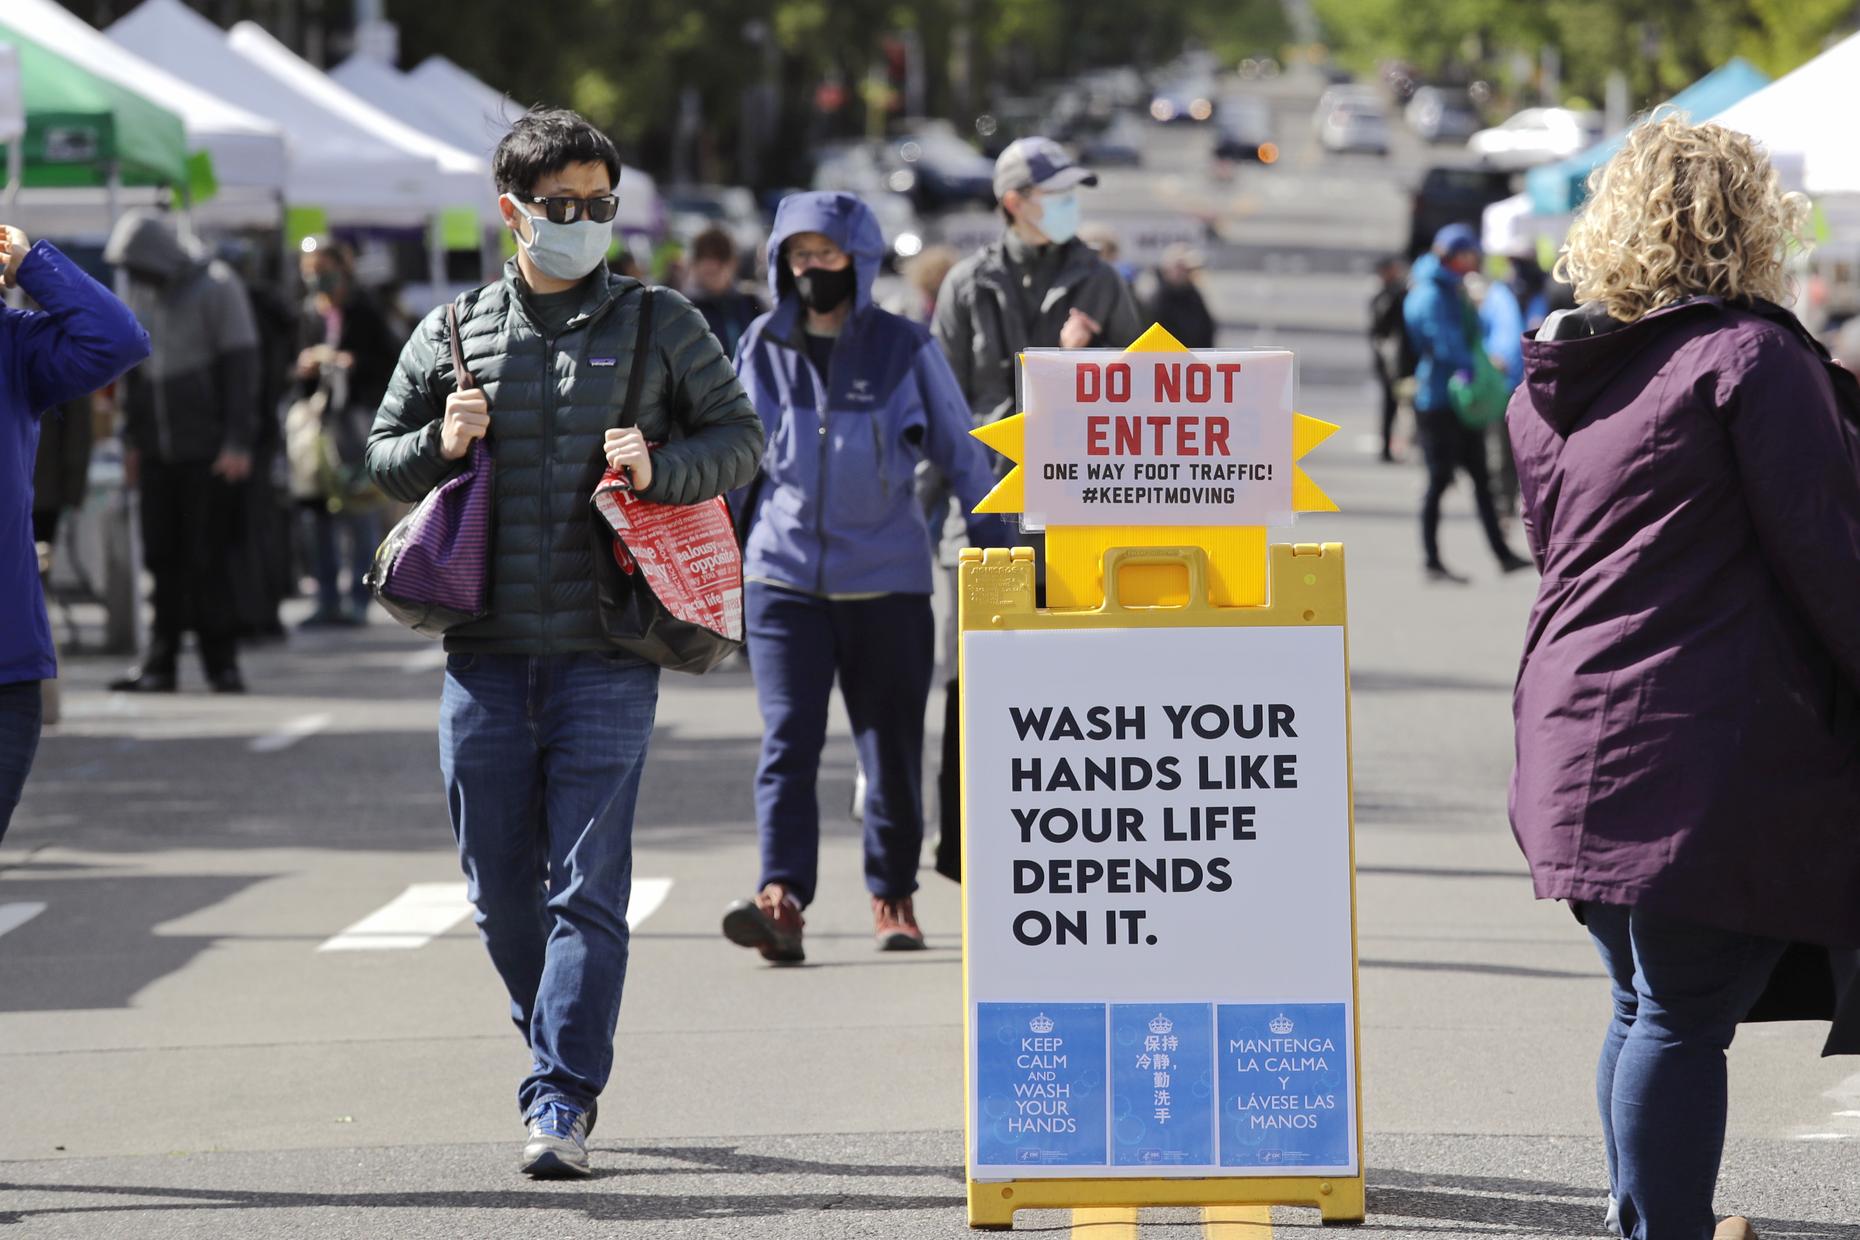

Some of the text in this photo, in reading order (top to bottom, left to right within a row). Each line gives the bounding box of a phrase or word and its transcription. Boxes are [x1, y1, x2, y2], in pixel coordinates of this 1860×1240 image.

[1075, 362, 1242, 403] DO NOT
[1087, 415, 1230, 456] ENTER
[1043, 463, 1274, 481] ONE WAY FOOT TRAFFIC!
[1082, 486, 1235, 505] #KEEPITMOVING
[1008, 703, 1299, 742] WASH YOUR
[1011, 755, 1298, 792] HANDS LIKE
[1010, 806, 1257, 843] YOUR LIFE
[1013, 857, 1233, 894] DEPENDS
[1012, 910, 1158, 946] ON IT.
[1021, 1037, 1063, 1052] KEEP
[1144, 1035, 1179, 1052] 保持
[1230, 1038, 1335, 1053] MANTENGA
[1016, 1054, 1067, 1069] CALM
[1237, 1057, 1329, 1072] LA CALMA
[1027, 1071, 1056, 1081] AND
[1278, 1076, 1290, 1090] Y
[1013, 1083, 1070, 1098] WASH
[1015, 1100, 1069, 1116] YOUR
[1237, 1092, 1335, 1110] LÁVESE LAS
[1008, 1117, 1076, 1133] HANDS
[1250, 1114, 1318, 1129] MANOS
